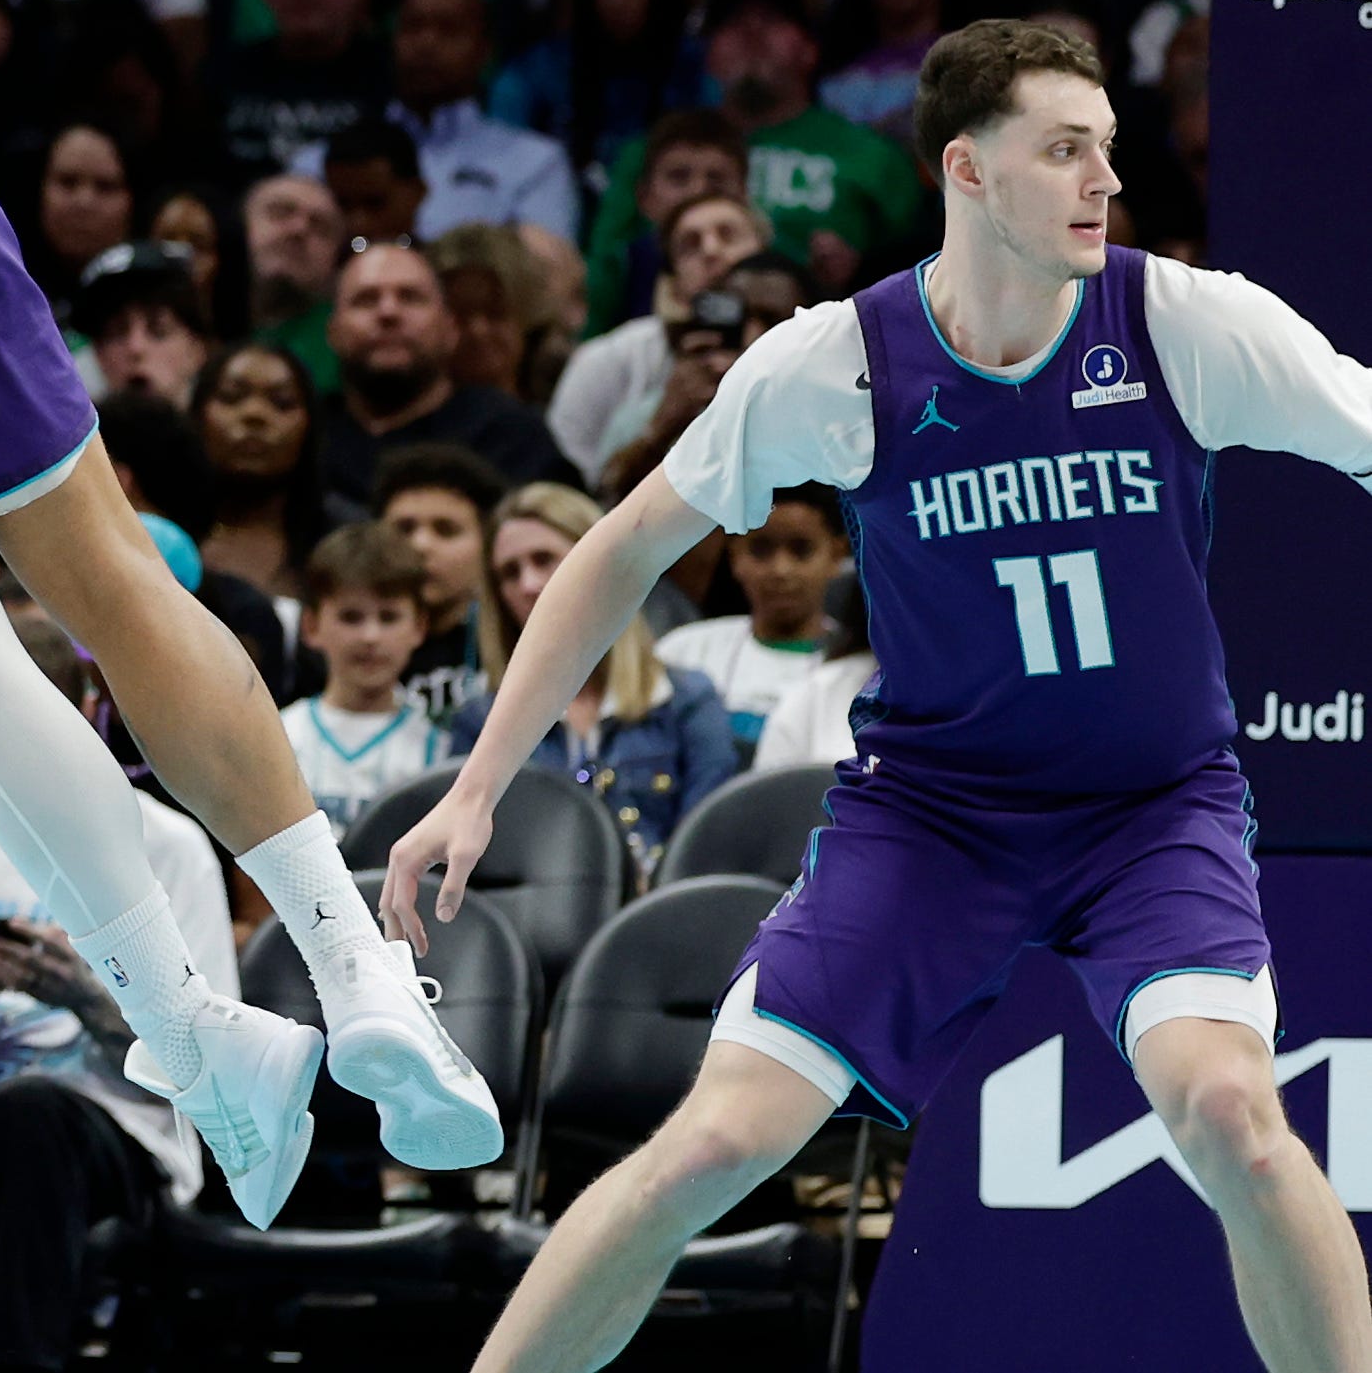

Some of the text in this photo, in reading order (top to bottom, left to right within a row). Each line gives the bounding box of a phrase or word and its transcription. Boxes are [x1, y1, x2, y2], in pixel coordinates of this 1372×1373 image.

[1076, 385, 1145, 405] Judi Health
[907, 450, 1164, 540] HORNETS
[992, 549, 1116, 677] 11
[1245, 689, 1365, 743] Judi
